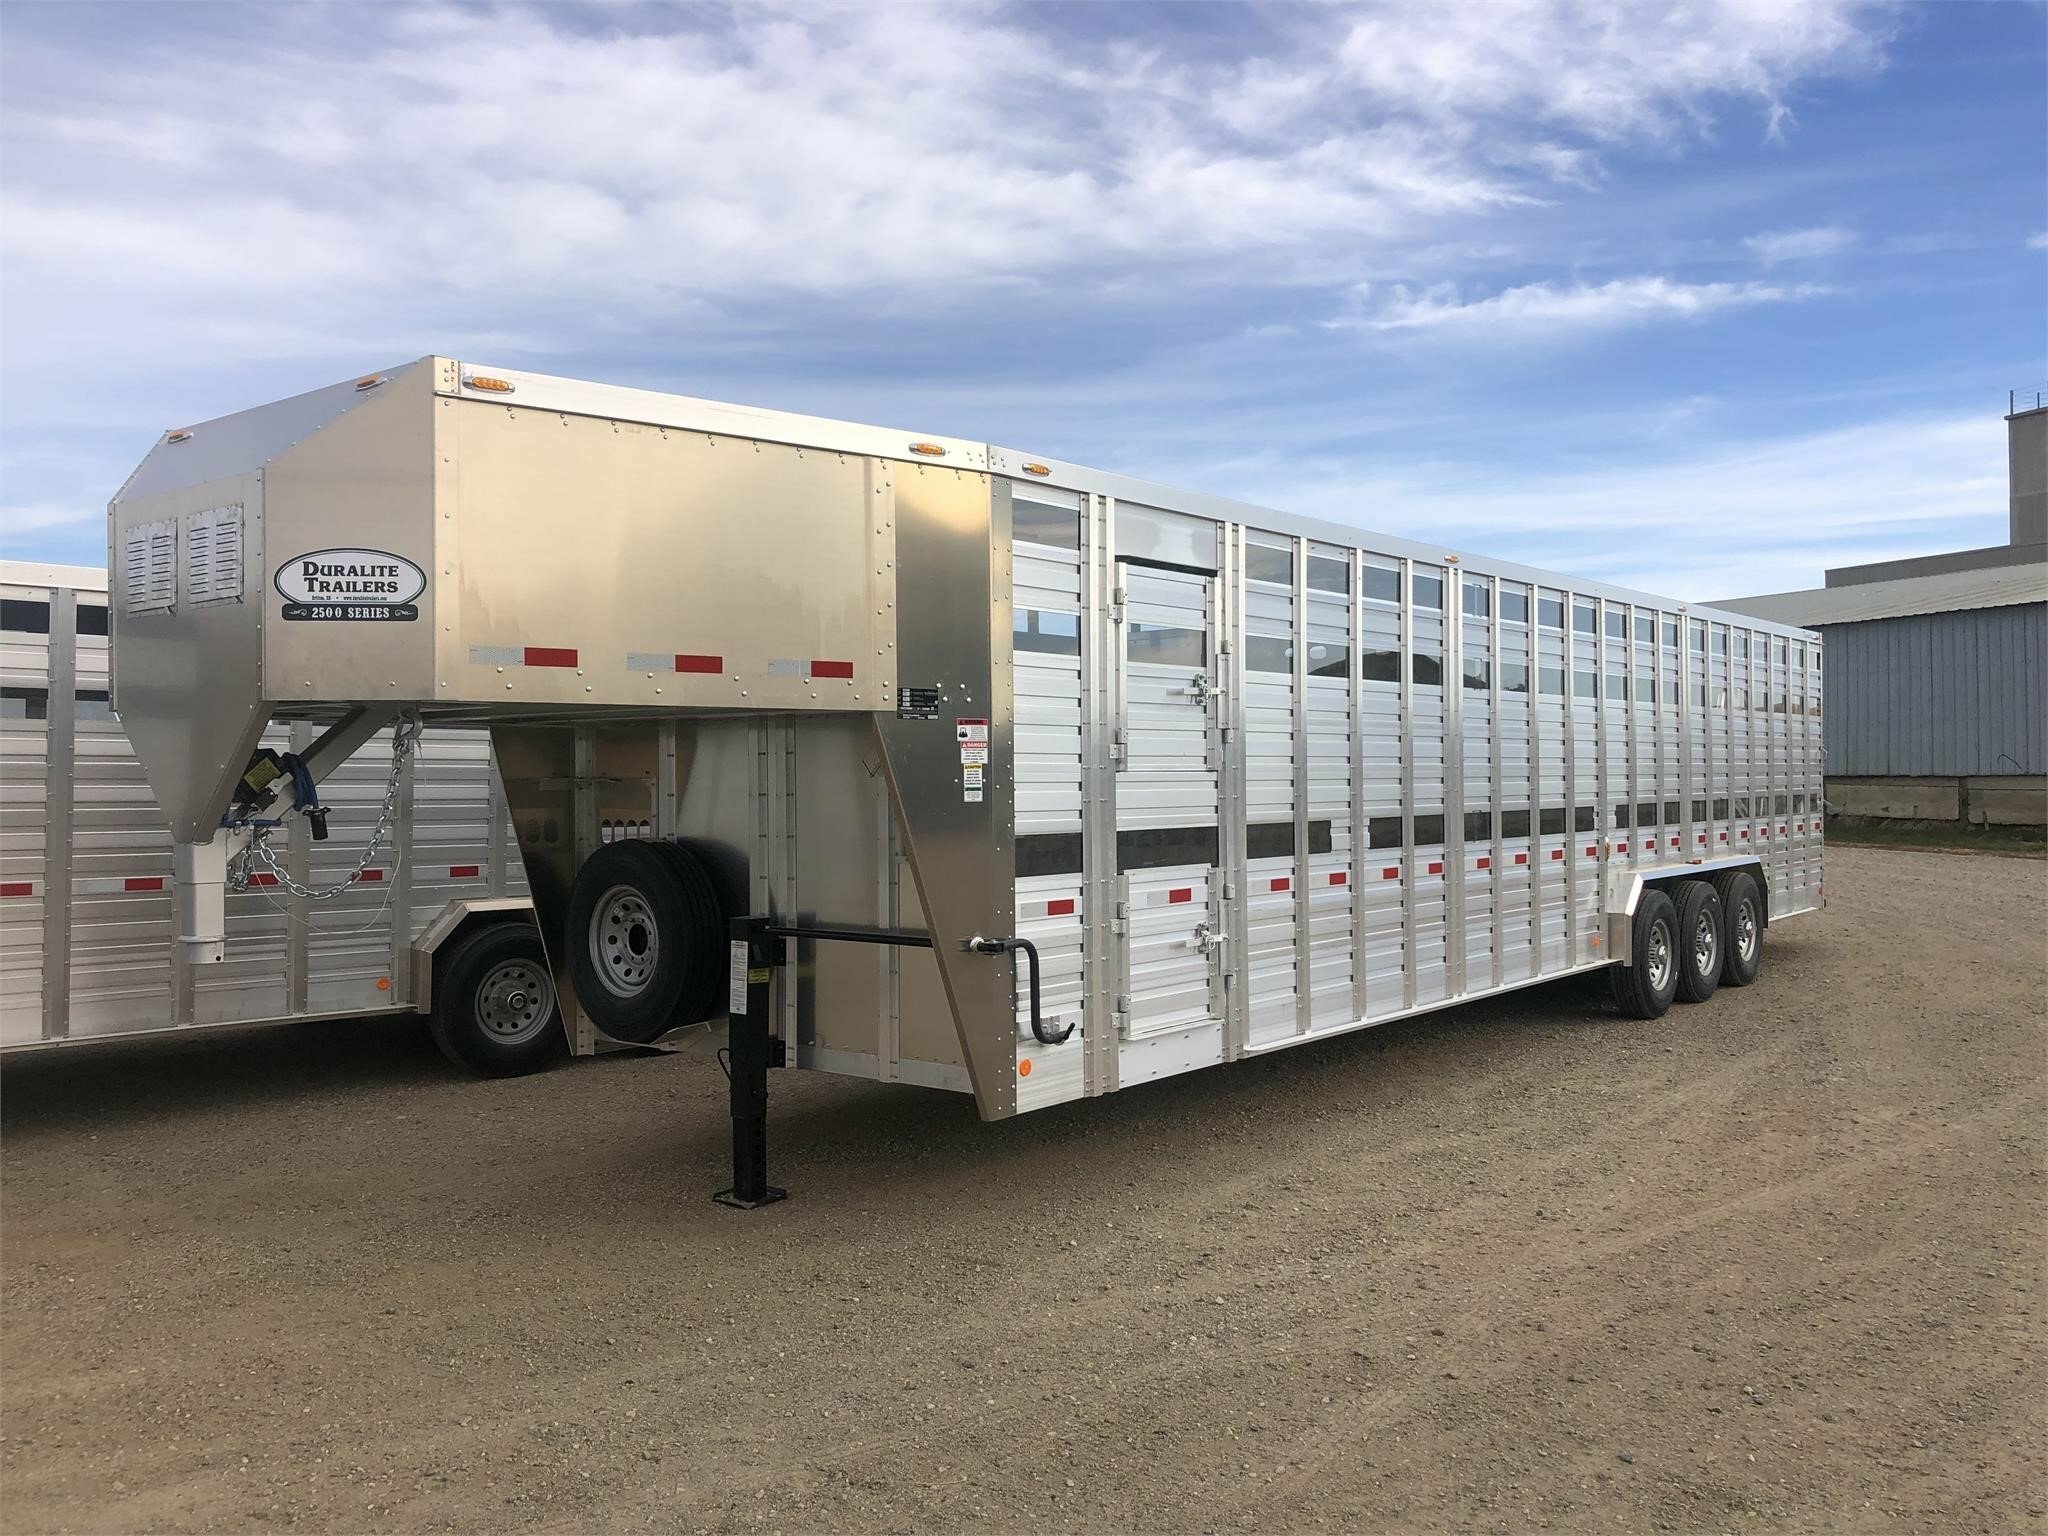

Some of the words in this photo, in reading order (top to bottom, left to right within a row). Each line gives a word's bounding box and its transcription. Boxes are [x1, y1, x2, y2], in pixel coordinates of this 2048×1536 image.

[302, 561, 399, 577] DURALITE
[303, 577, 399, 593] TRAILERS
[311, 607, 342, 619] 2500
[347, 607, 390, 619] SERIES
